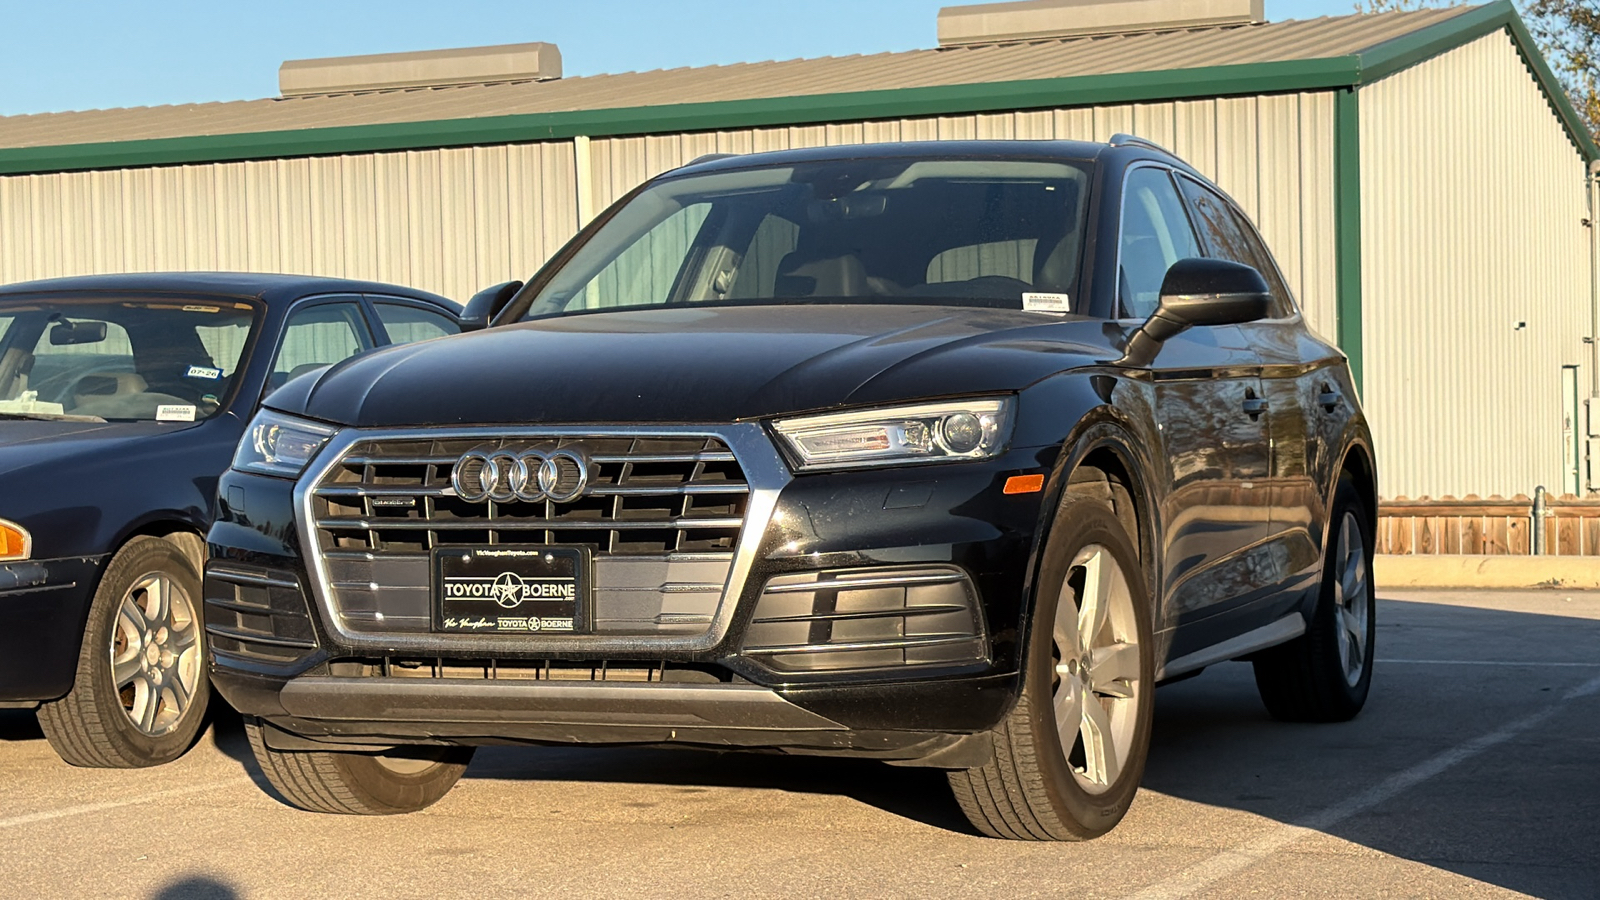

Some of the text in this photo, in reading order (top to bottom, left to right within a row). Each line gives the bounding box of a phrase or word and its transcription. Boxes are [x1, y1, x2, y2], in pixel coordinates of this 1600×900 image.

[444, 583, 501, 596] TOYOTA
[523, 584, 575, 596] BOERNE
[497, 620, 527, 628] TOYOTA
[541, 620, 573, 628] BOERNE
